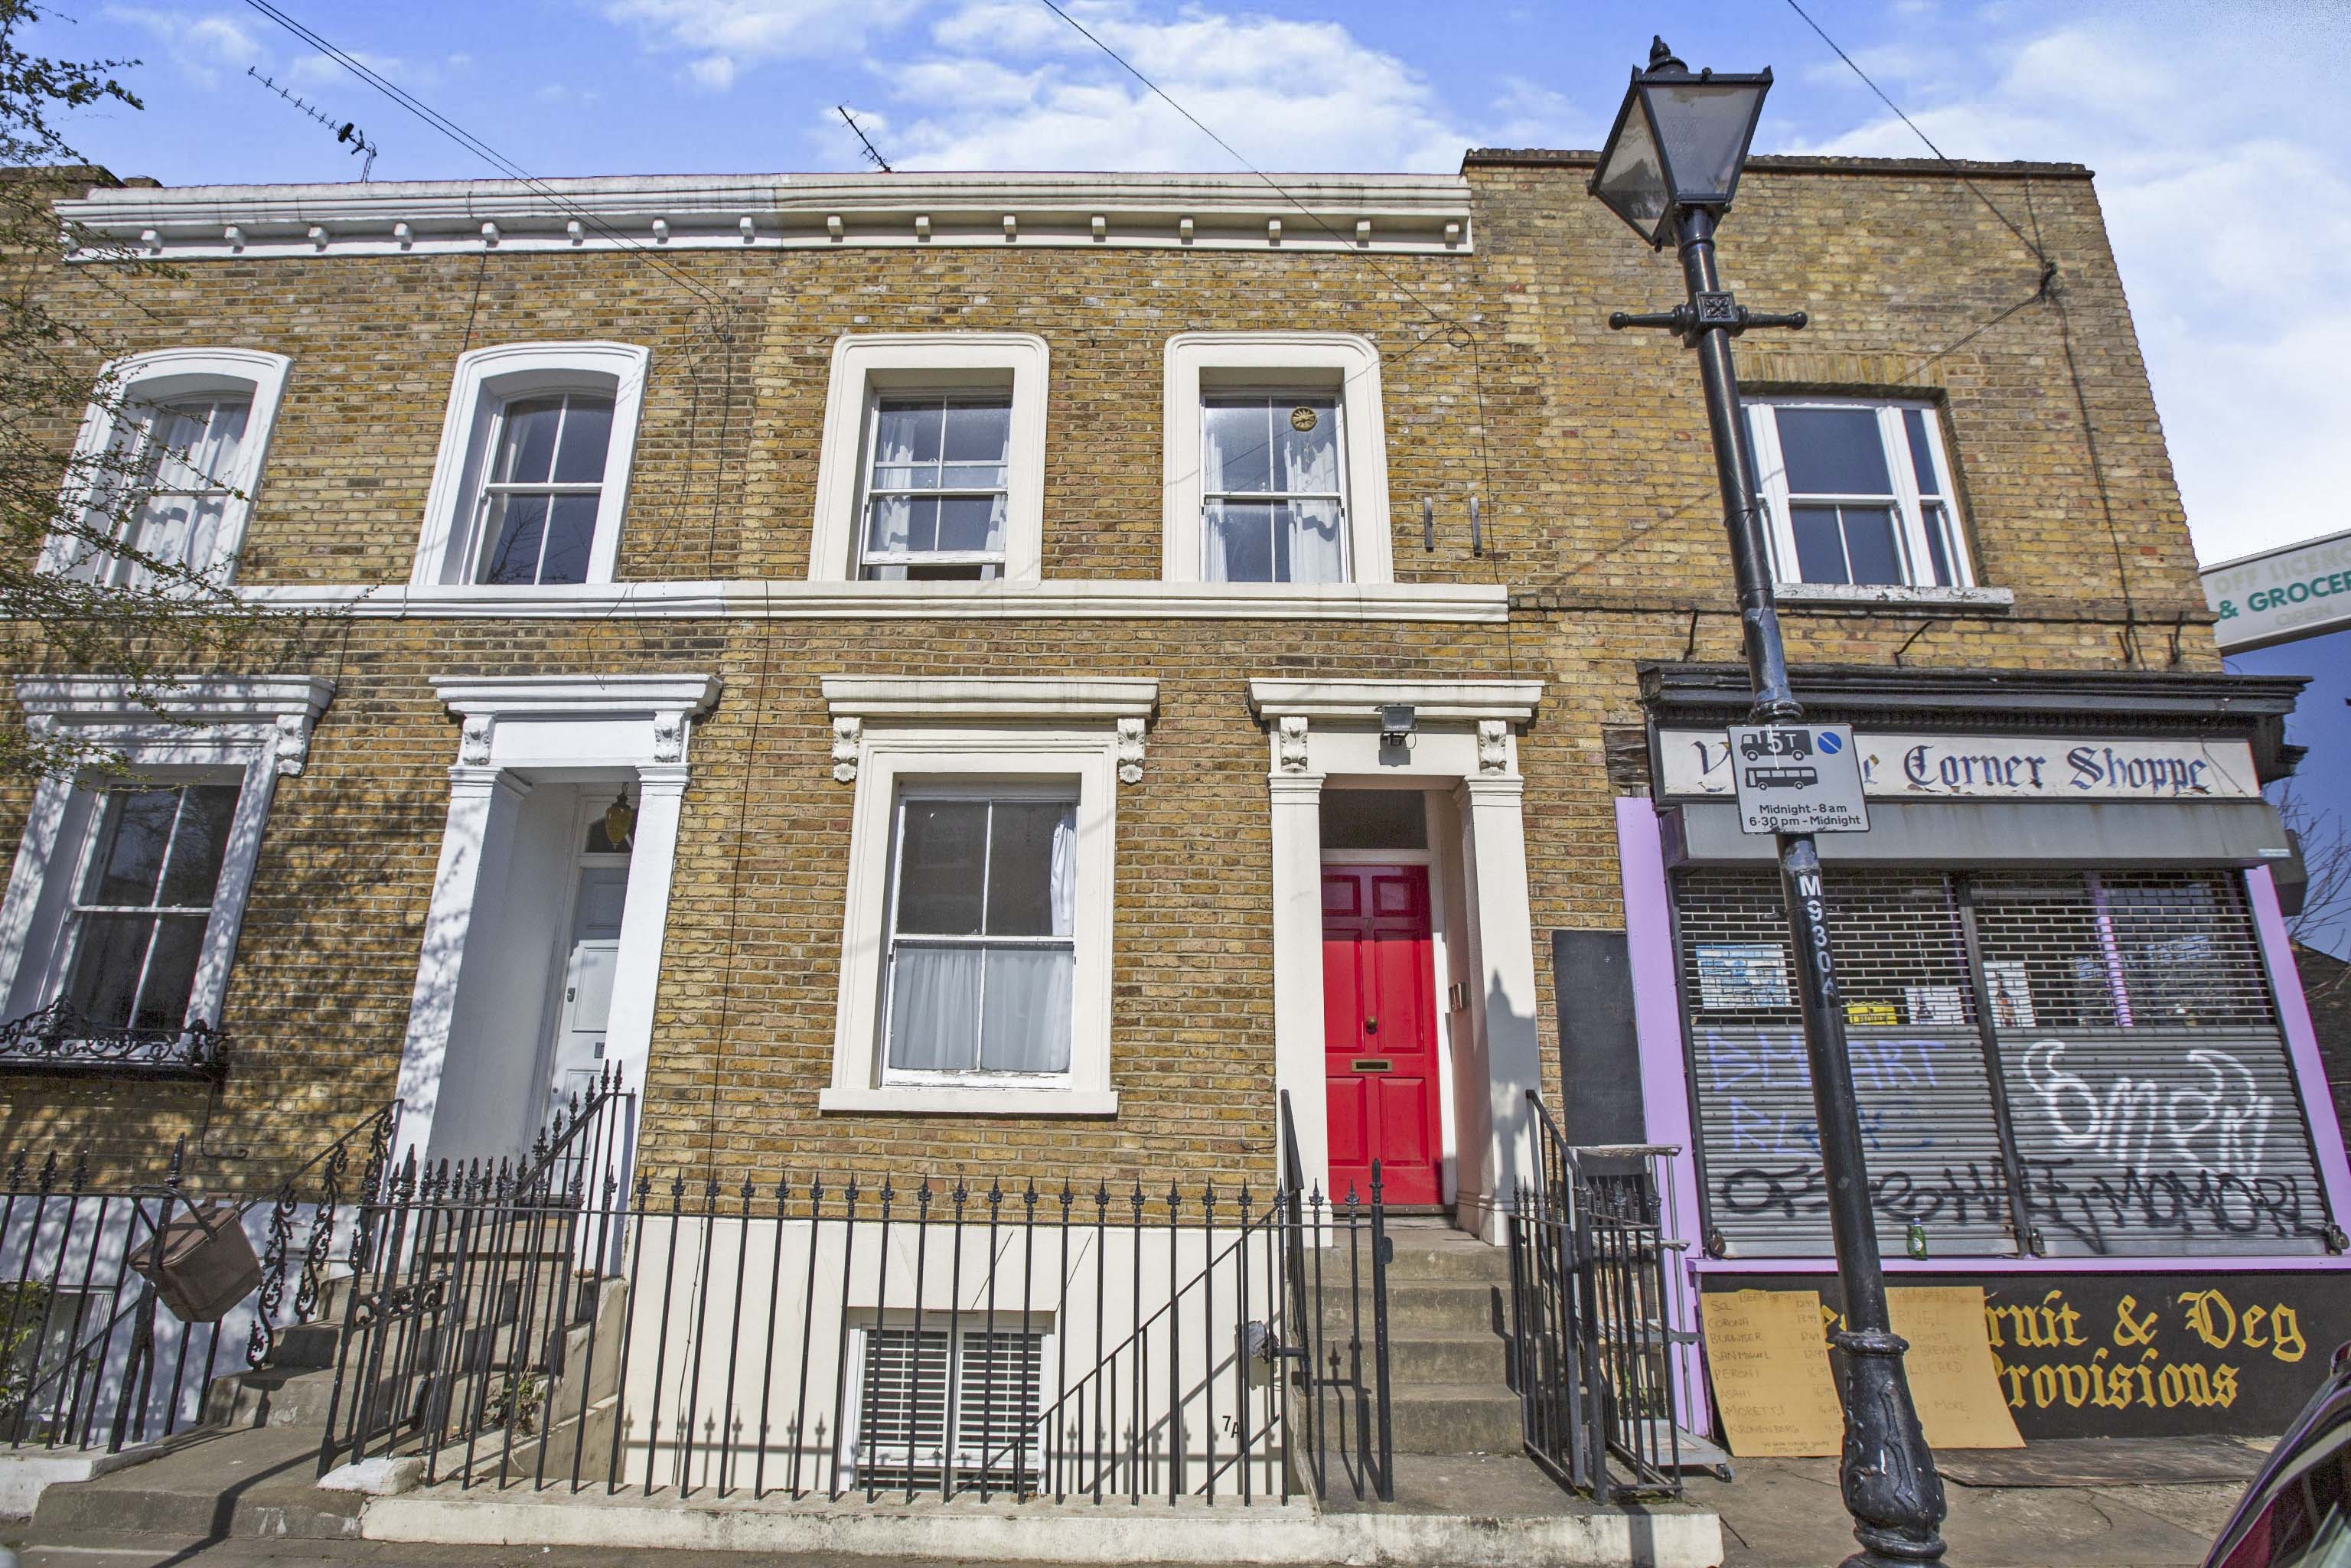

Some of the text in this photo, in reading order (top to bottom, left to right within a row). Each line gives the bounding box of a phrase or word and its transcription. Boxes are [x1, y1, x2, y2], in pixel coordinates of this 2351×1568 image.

[2219, 600, 2239, 620] &
[1904, 745, 2047, 789] Corner
[2067, 747, 2210, 796] Shoppe
[1759, 804, 1811, 816] Midnight
[1809, 816, 1861, 826] Midnight
[1985, 1290, 2089, 1347] ruit
[2113, 1295, 2159, 1347] &
[1222, 1415, 1240, 1439] 7A
